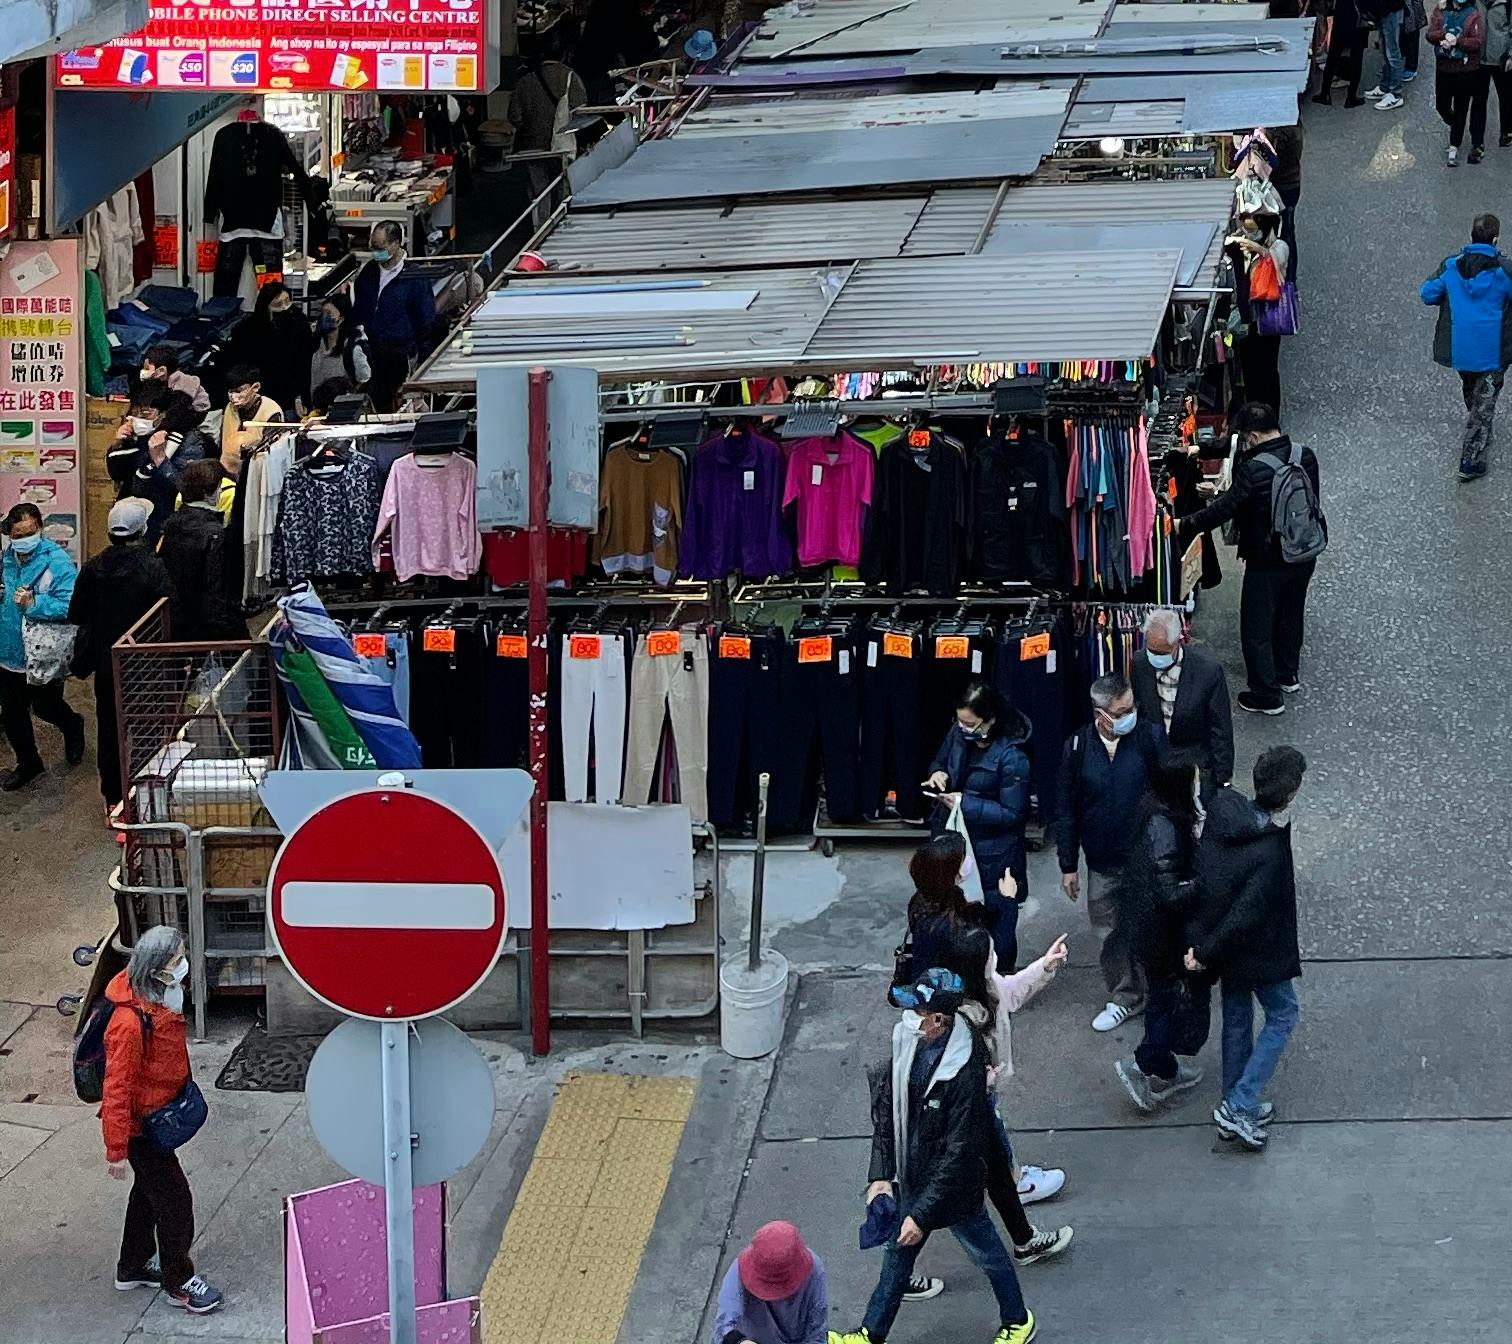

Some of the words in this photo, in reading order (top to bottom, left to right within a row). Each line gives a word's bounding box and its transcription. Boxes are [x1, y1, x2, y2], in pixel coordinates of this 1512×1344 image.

[198, 8, 259, 21] PHONE
[262, 9, 328, 22] DIRECT
[330, 10, 406, 23] SELLING
[409, 11, 480, 24] CENTRE
[145, 35, 170, 47] buat
[173, 36, 206, 50] Orang
[208, 36, 261, 48] Indonesia
[270, 36, 290, 50] Ang
[291, 36, 312, 51] shop
[339, 39, 349, 51] ay
[351, 38, 390, 52] espesyal
[391, 40, 411, 52] para
[412, 40, 423, 50] sa
[425, 40, 443, 53] mga
[445, 39, 478, 53] Filipino
[180, 61, 202, 73] $50
[231, 61, 254, 73] $20
[2, 297, 72, 314] 國際萬能咭
[0, 390, 75, 412] 在此發售
